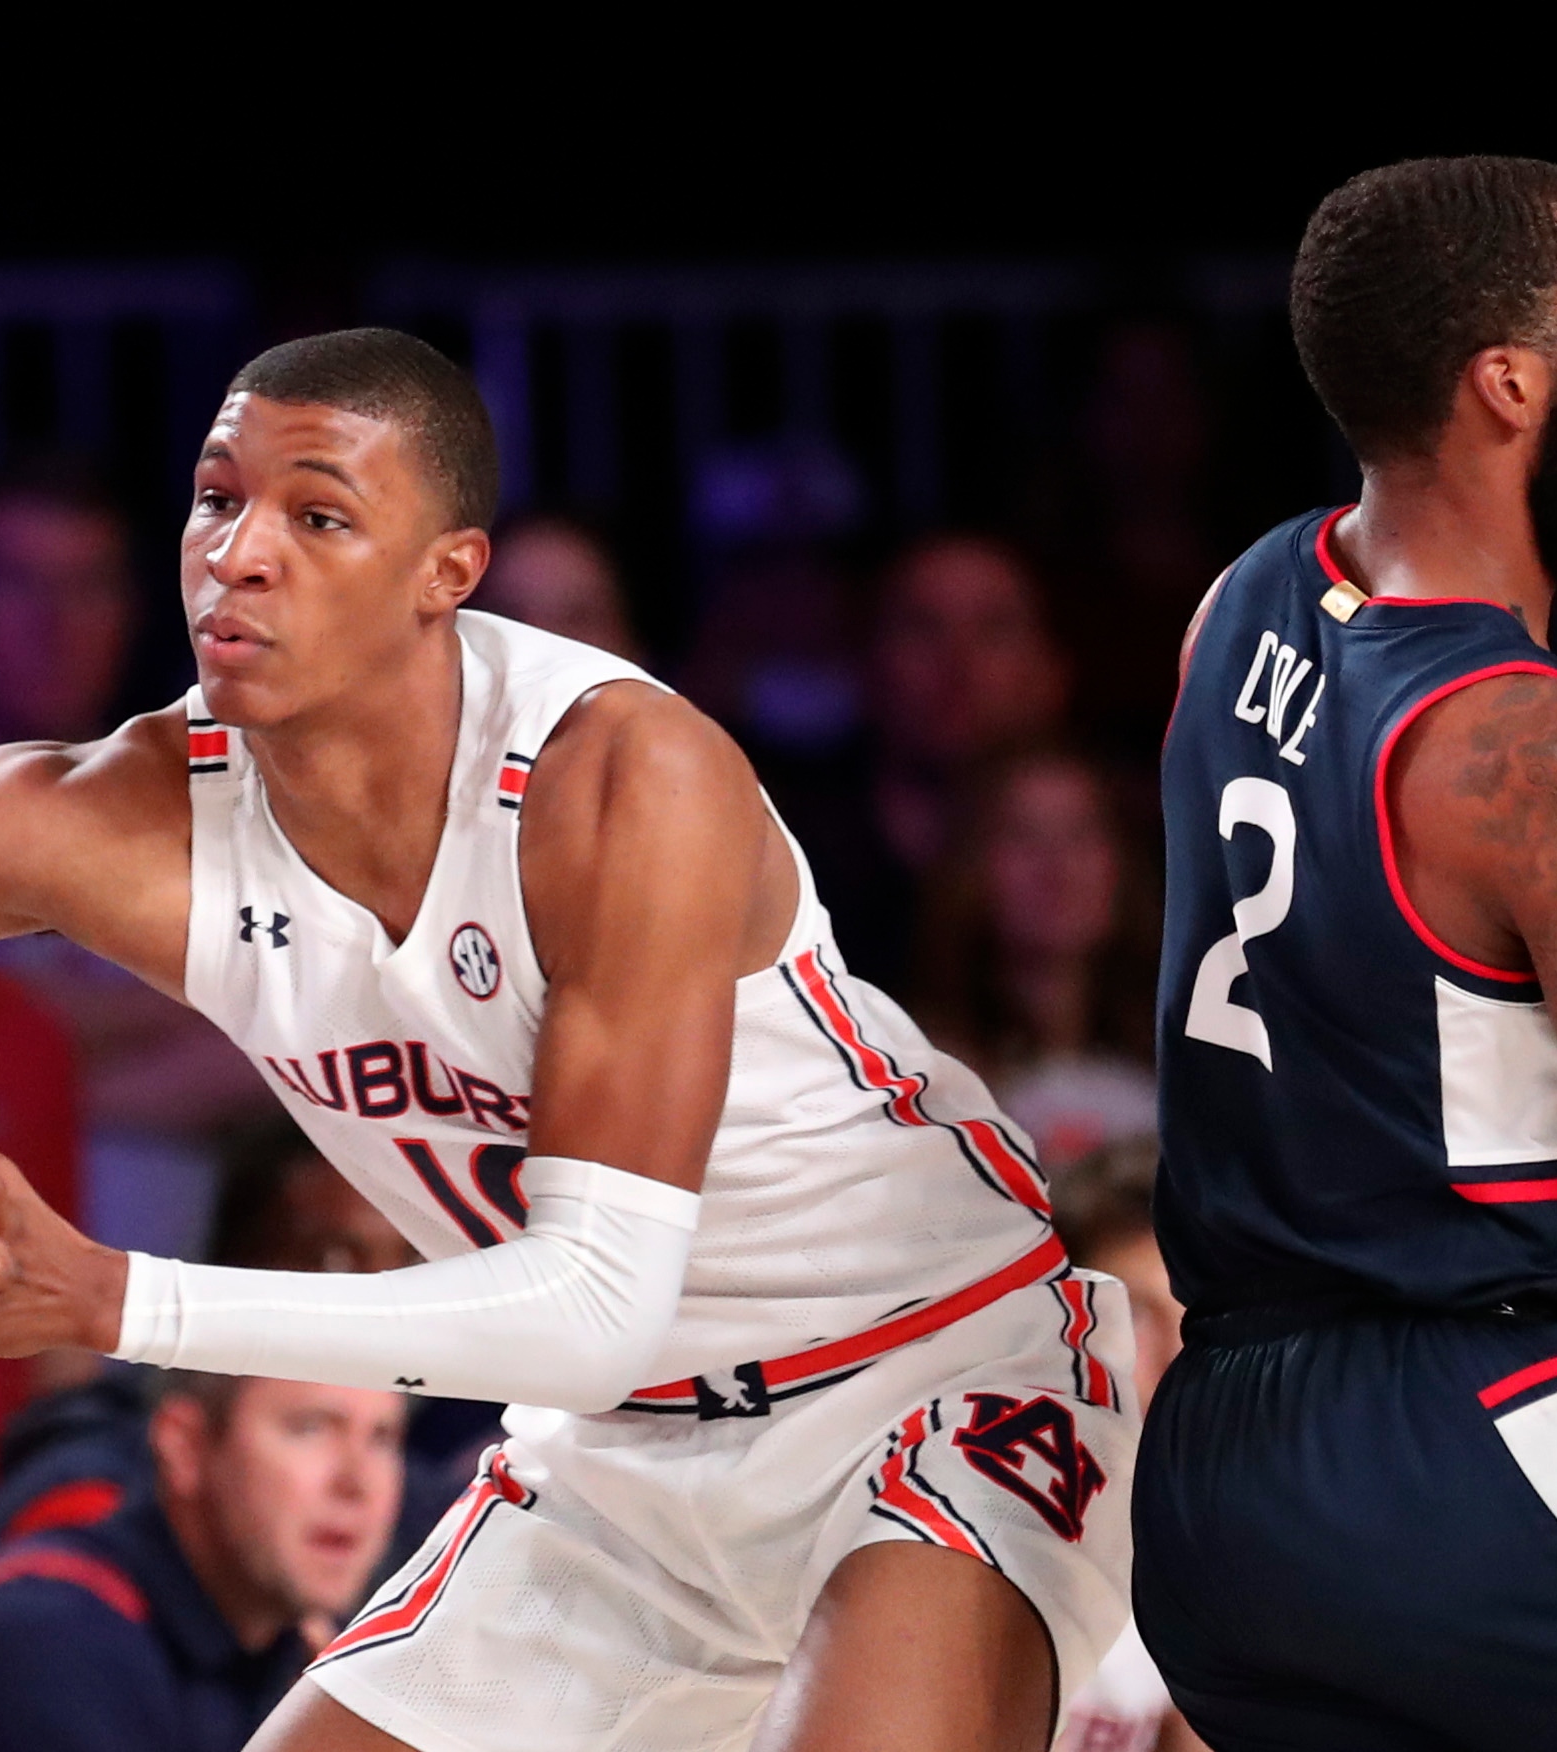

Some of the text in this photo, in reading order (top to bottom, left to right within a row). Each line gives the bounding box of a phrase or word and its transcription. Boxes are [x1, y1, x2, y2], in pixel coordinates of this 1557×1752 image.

[1235, 630, 1326, 766] COLE
[1185, 776, 1296, 1073] 2
[263, 1039, 531, 1131] UBUR
